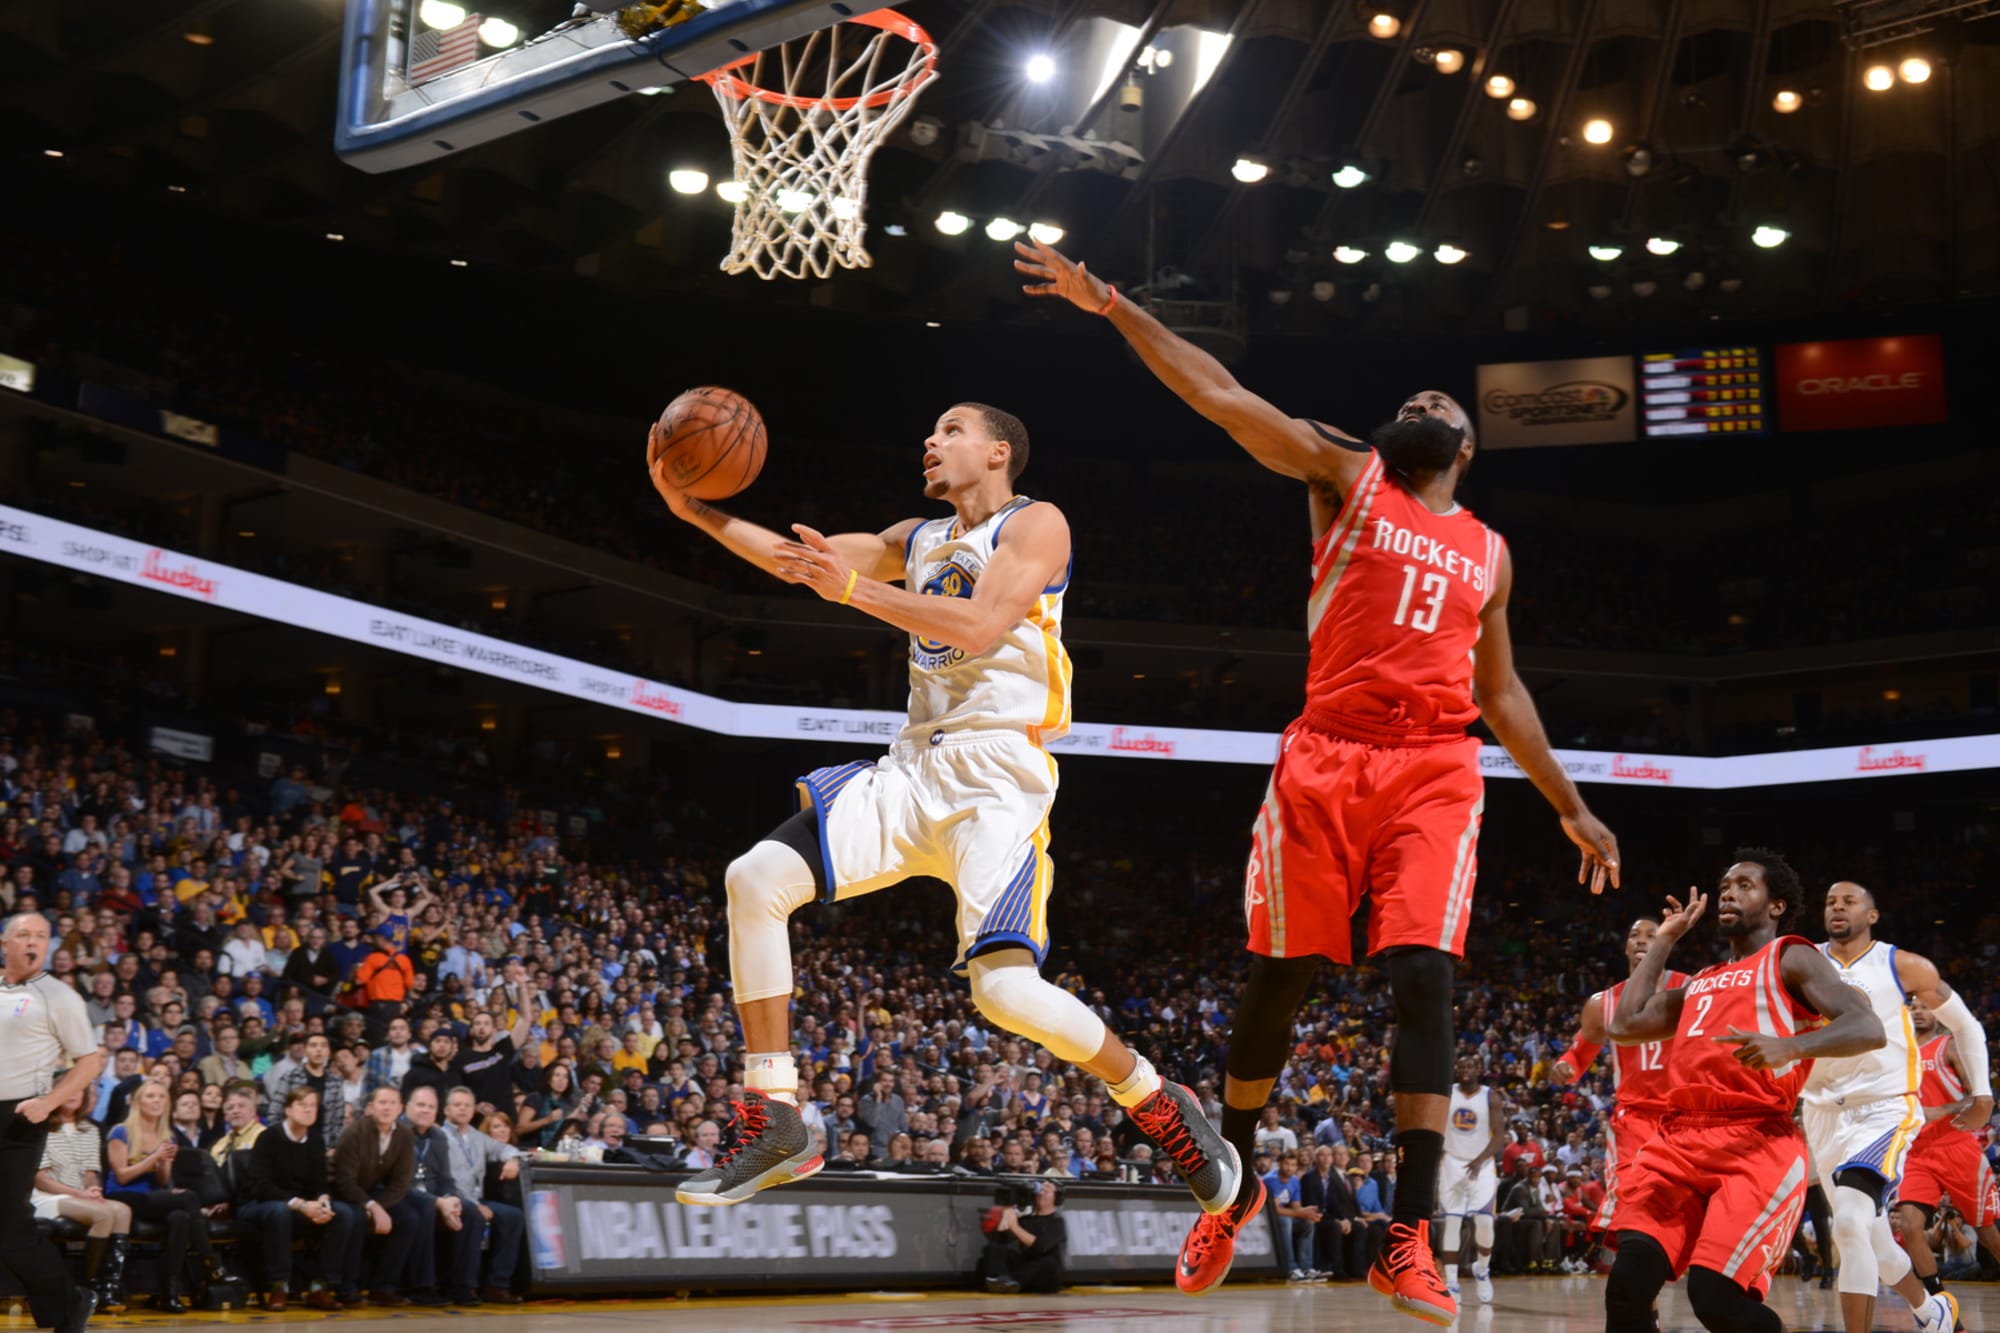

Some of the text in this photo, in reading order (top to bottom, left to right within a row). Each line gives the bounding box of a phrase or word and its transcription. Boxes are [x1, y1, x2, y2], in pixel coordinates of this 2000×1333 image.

[1797, 372, 1925, 395] ORACLE
[1371, 516, 1485, 592] ROCKETS
[941, 572, 962, 597] 30
[1393, 564, 1449, 634] 13
[797, 717, 840, 732] EAT
[1106, 725, 1176, 757] Lucky
[1855, 743, 1927, 773] Lucky
[1686, 994, 1713, 1037] 2
[1640, 1040, 1664, 1071] 12
[575, 1200, 898, 1260] NBA LEAGUE PASS
